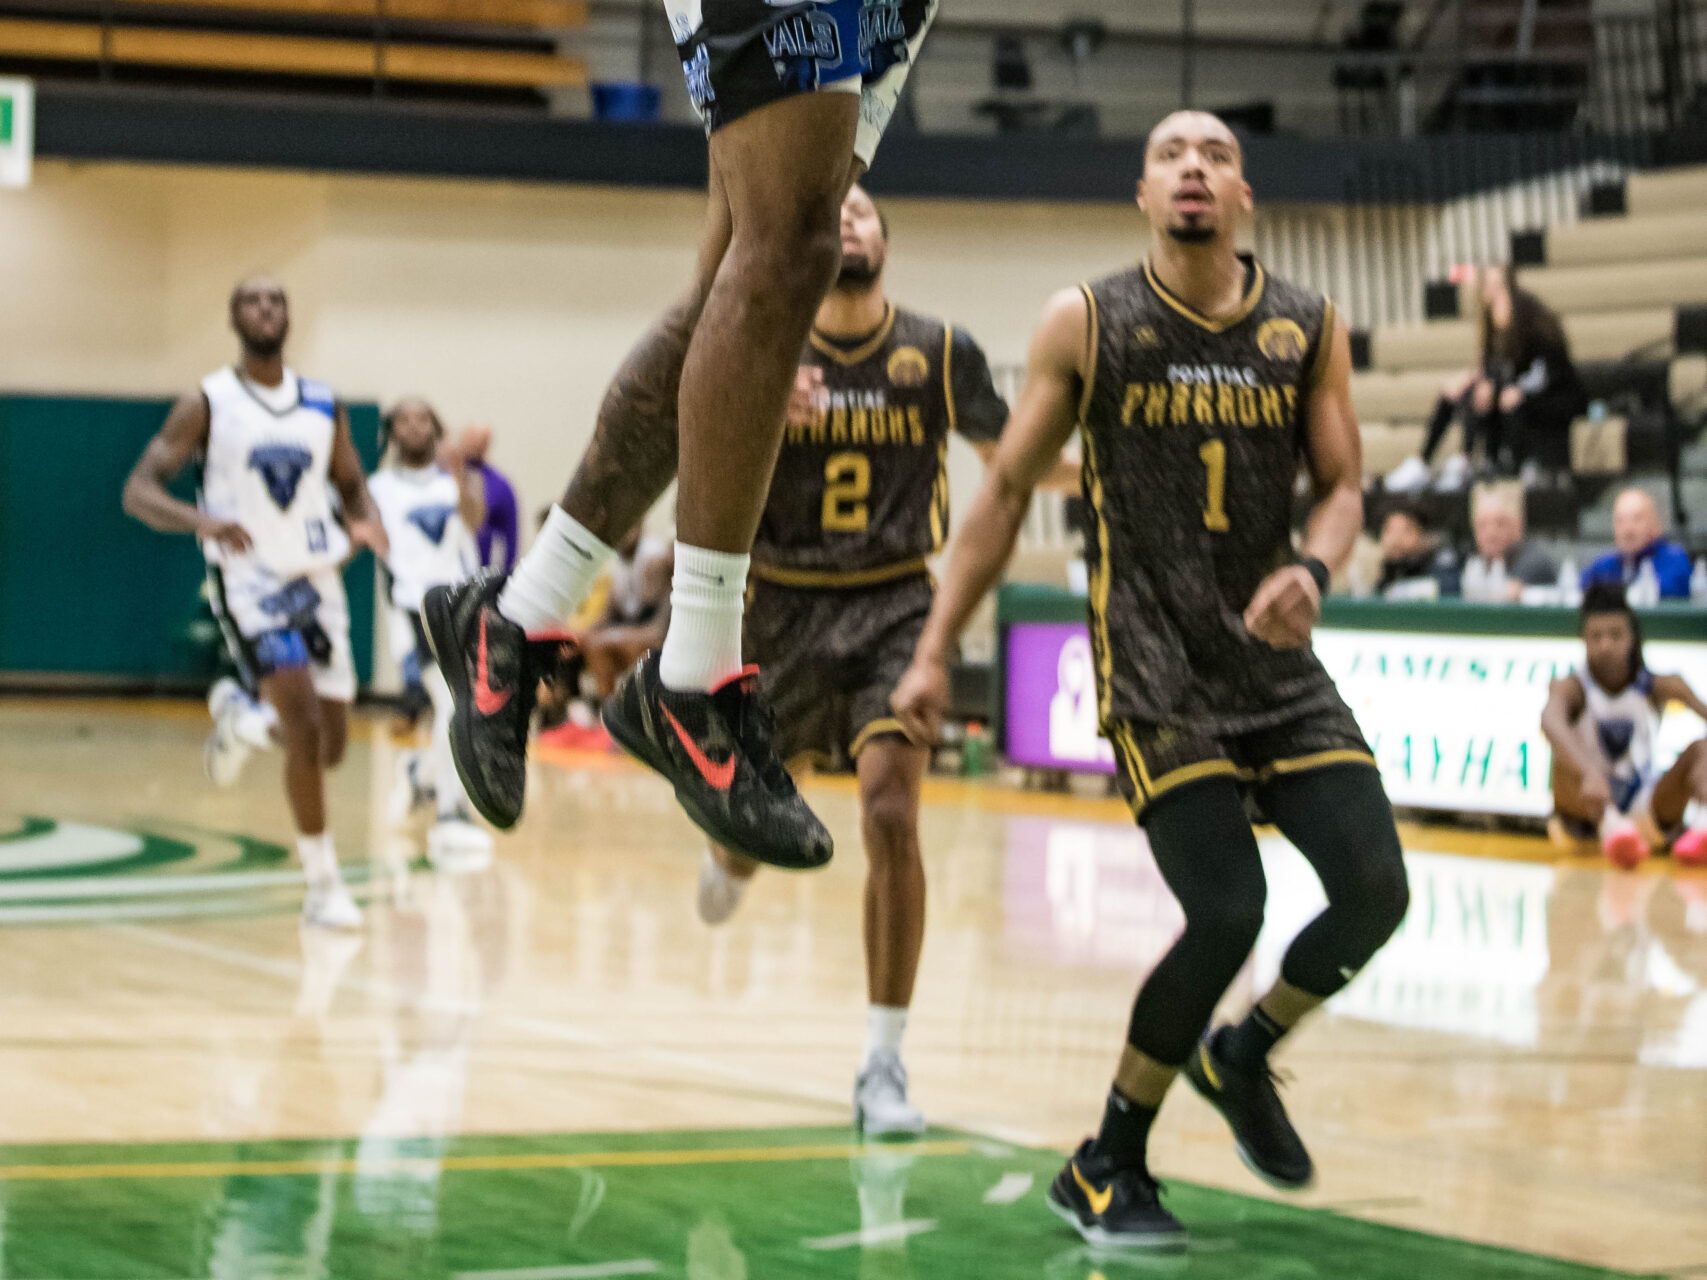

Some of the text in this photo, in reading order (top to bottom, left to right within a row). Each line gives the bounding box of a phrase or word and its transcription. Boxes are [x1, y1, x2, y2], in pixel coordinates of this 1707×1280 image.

[821, 452, 870, 531] 2
[1199, 439, 1229, 531] 1
[1349, 651, 1577, 687] JAMESTO
[1370, 731, 1554, 794] AYHA
